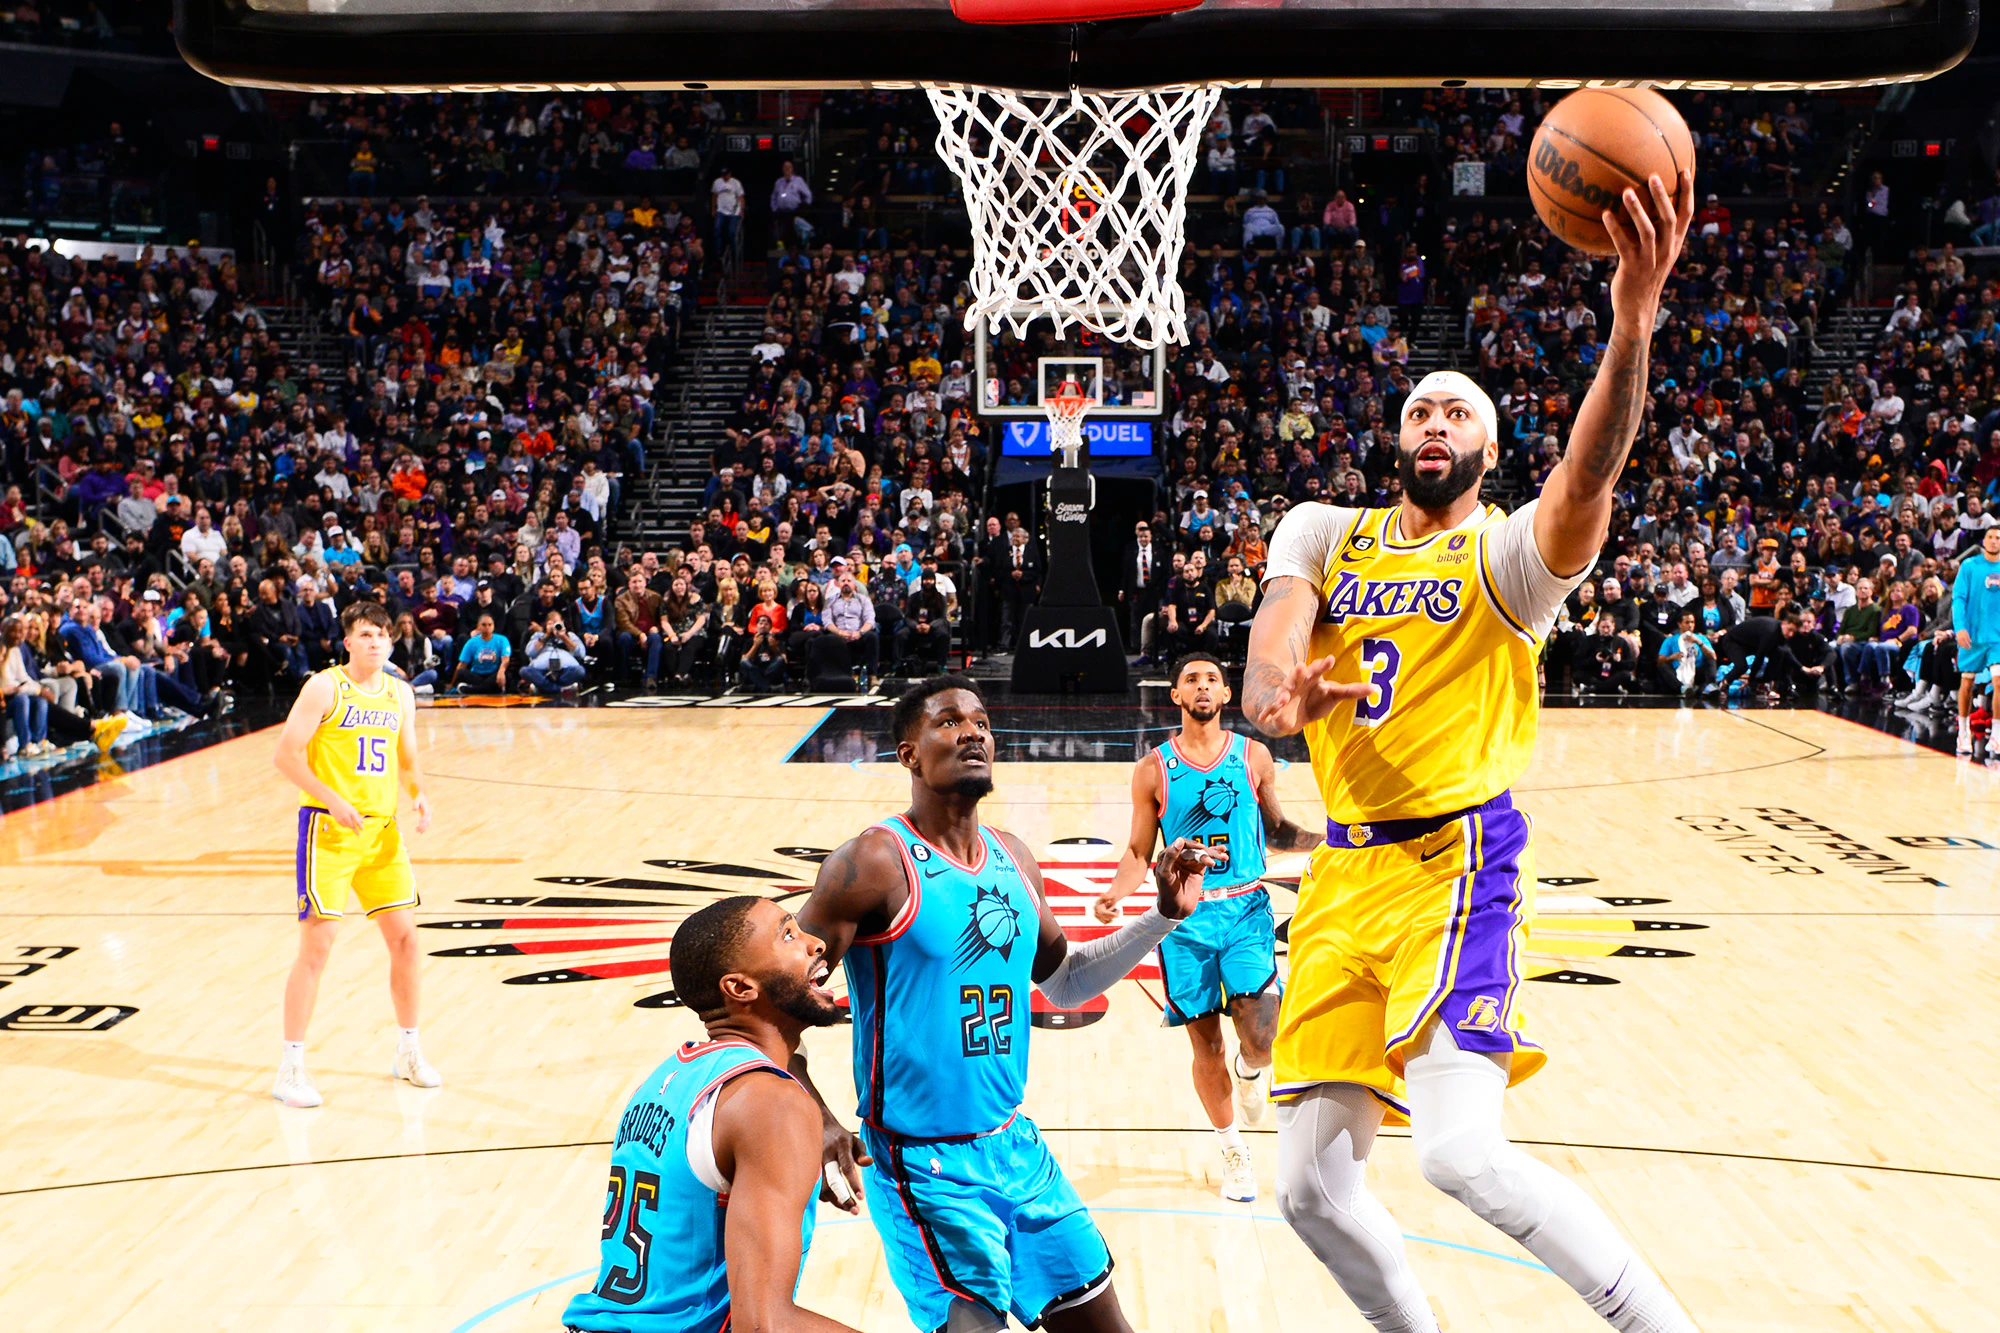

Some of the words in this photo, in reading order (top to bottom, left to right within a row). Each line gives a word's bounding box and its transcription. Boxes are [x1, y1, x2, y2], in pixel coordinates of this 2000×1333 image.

[1535, 137, 1622, 213] Wilson
[1046, 424, 1144, 441] DUEL
[1055, 502, 1084, 514] Season
[1063, 511, 1087, 524] Giving
[1355, 537, 1373, 550] 6
[1436, 552, 1469, 564] bibigo
[1321, 571, 1463, 624] LAKERS
[1354, 638, 1401, 727] 3
[338, 705, 399, 730] LAKERS
[356, 737, 386, 772] 15
[913, 845, 929, 861] 6
[1674, 815, 1825, 875] CENTER
[1739, 806, 1950, 887] FOOTPRINT
[995, 865, 1015, 873] PayPal
[960, 984, 1013, 1057] 22
[616, 1102, 675, 1158] BRIDGES
